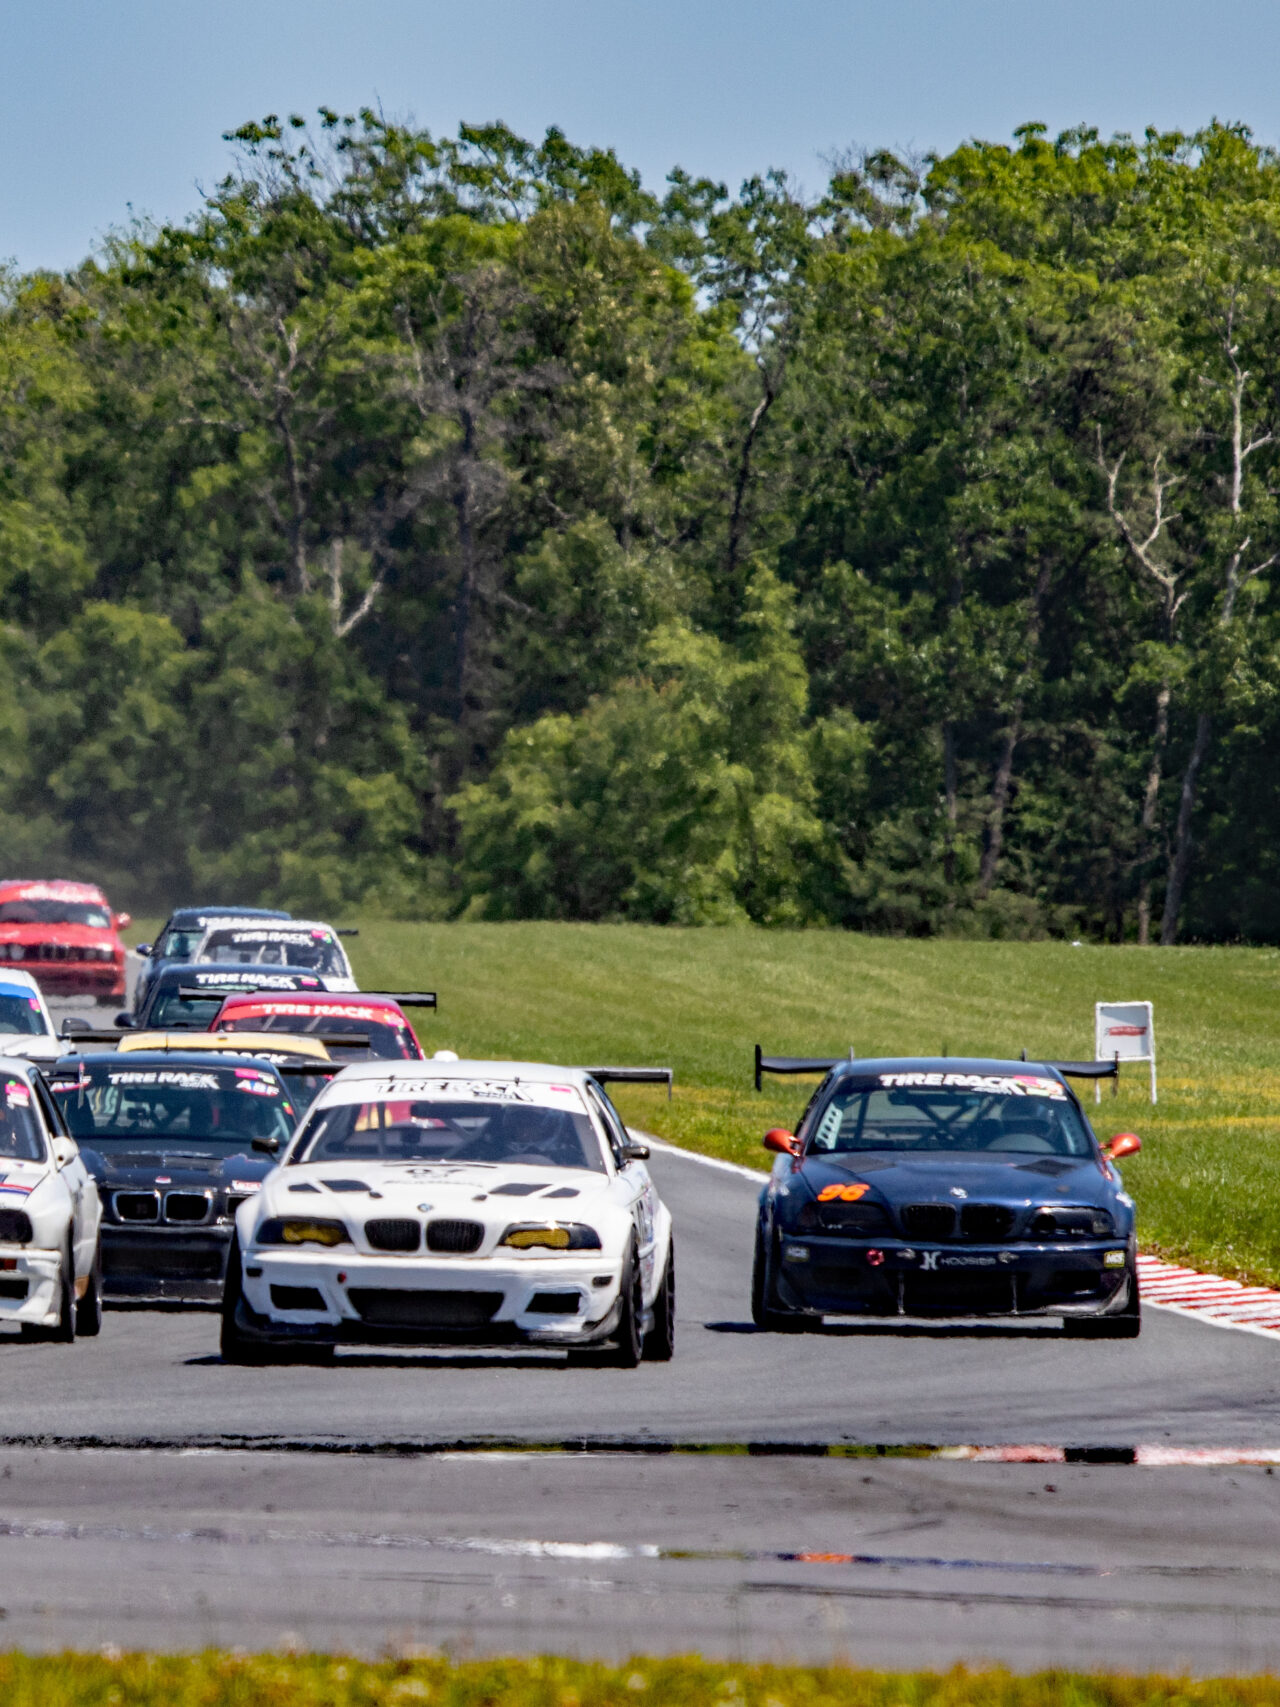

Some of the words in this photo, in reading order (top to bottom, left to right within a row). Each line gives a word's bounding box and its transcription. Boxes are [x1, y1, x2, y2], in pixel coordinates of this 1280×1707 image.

[262, 1003, 311, 1014] TIRE
[313, 1004, 374, 1019] RACK
[108, 1072, 157, 1085] TIRE
[158, 1071, 220, 1089] RACK
[879, 1072, 943, 1087] TIRE
[943, 1073, 1026, 1096] RACK
[817, 1183, 870, 1202] 96
